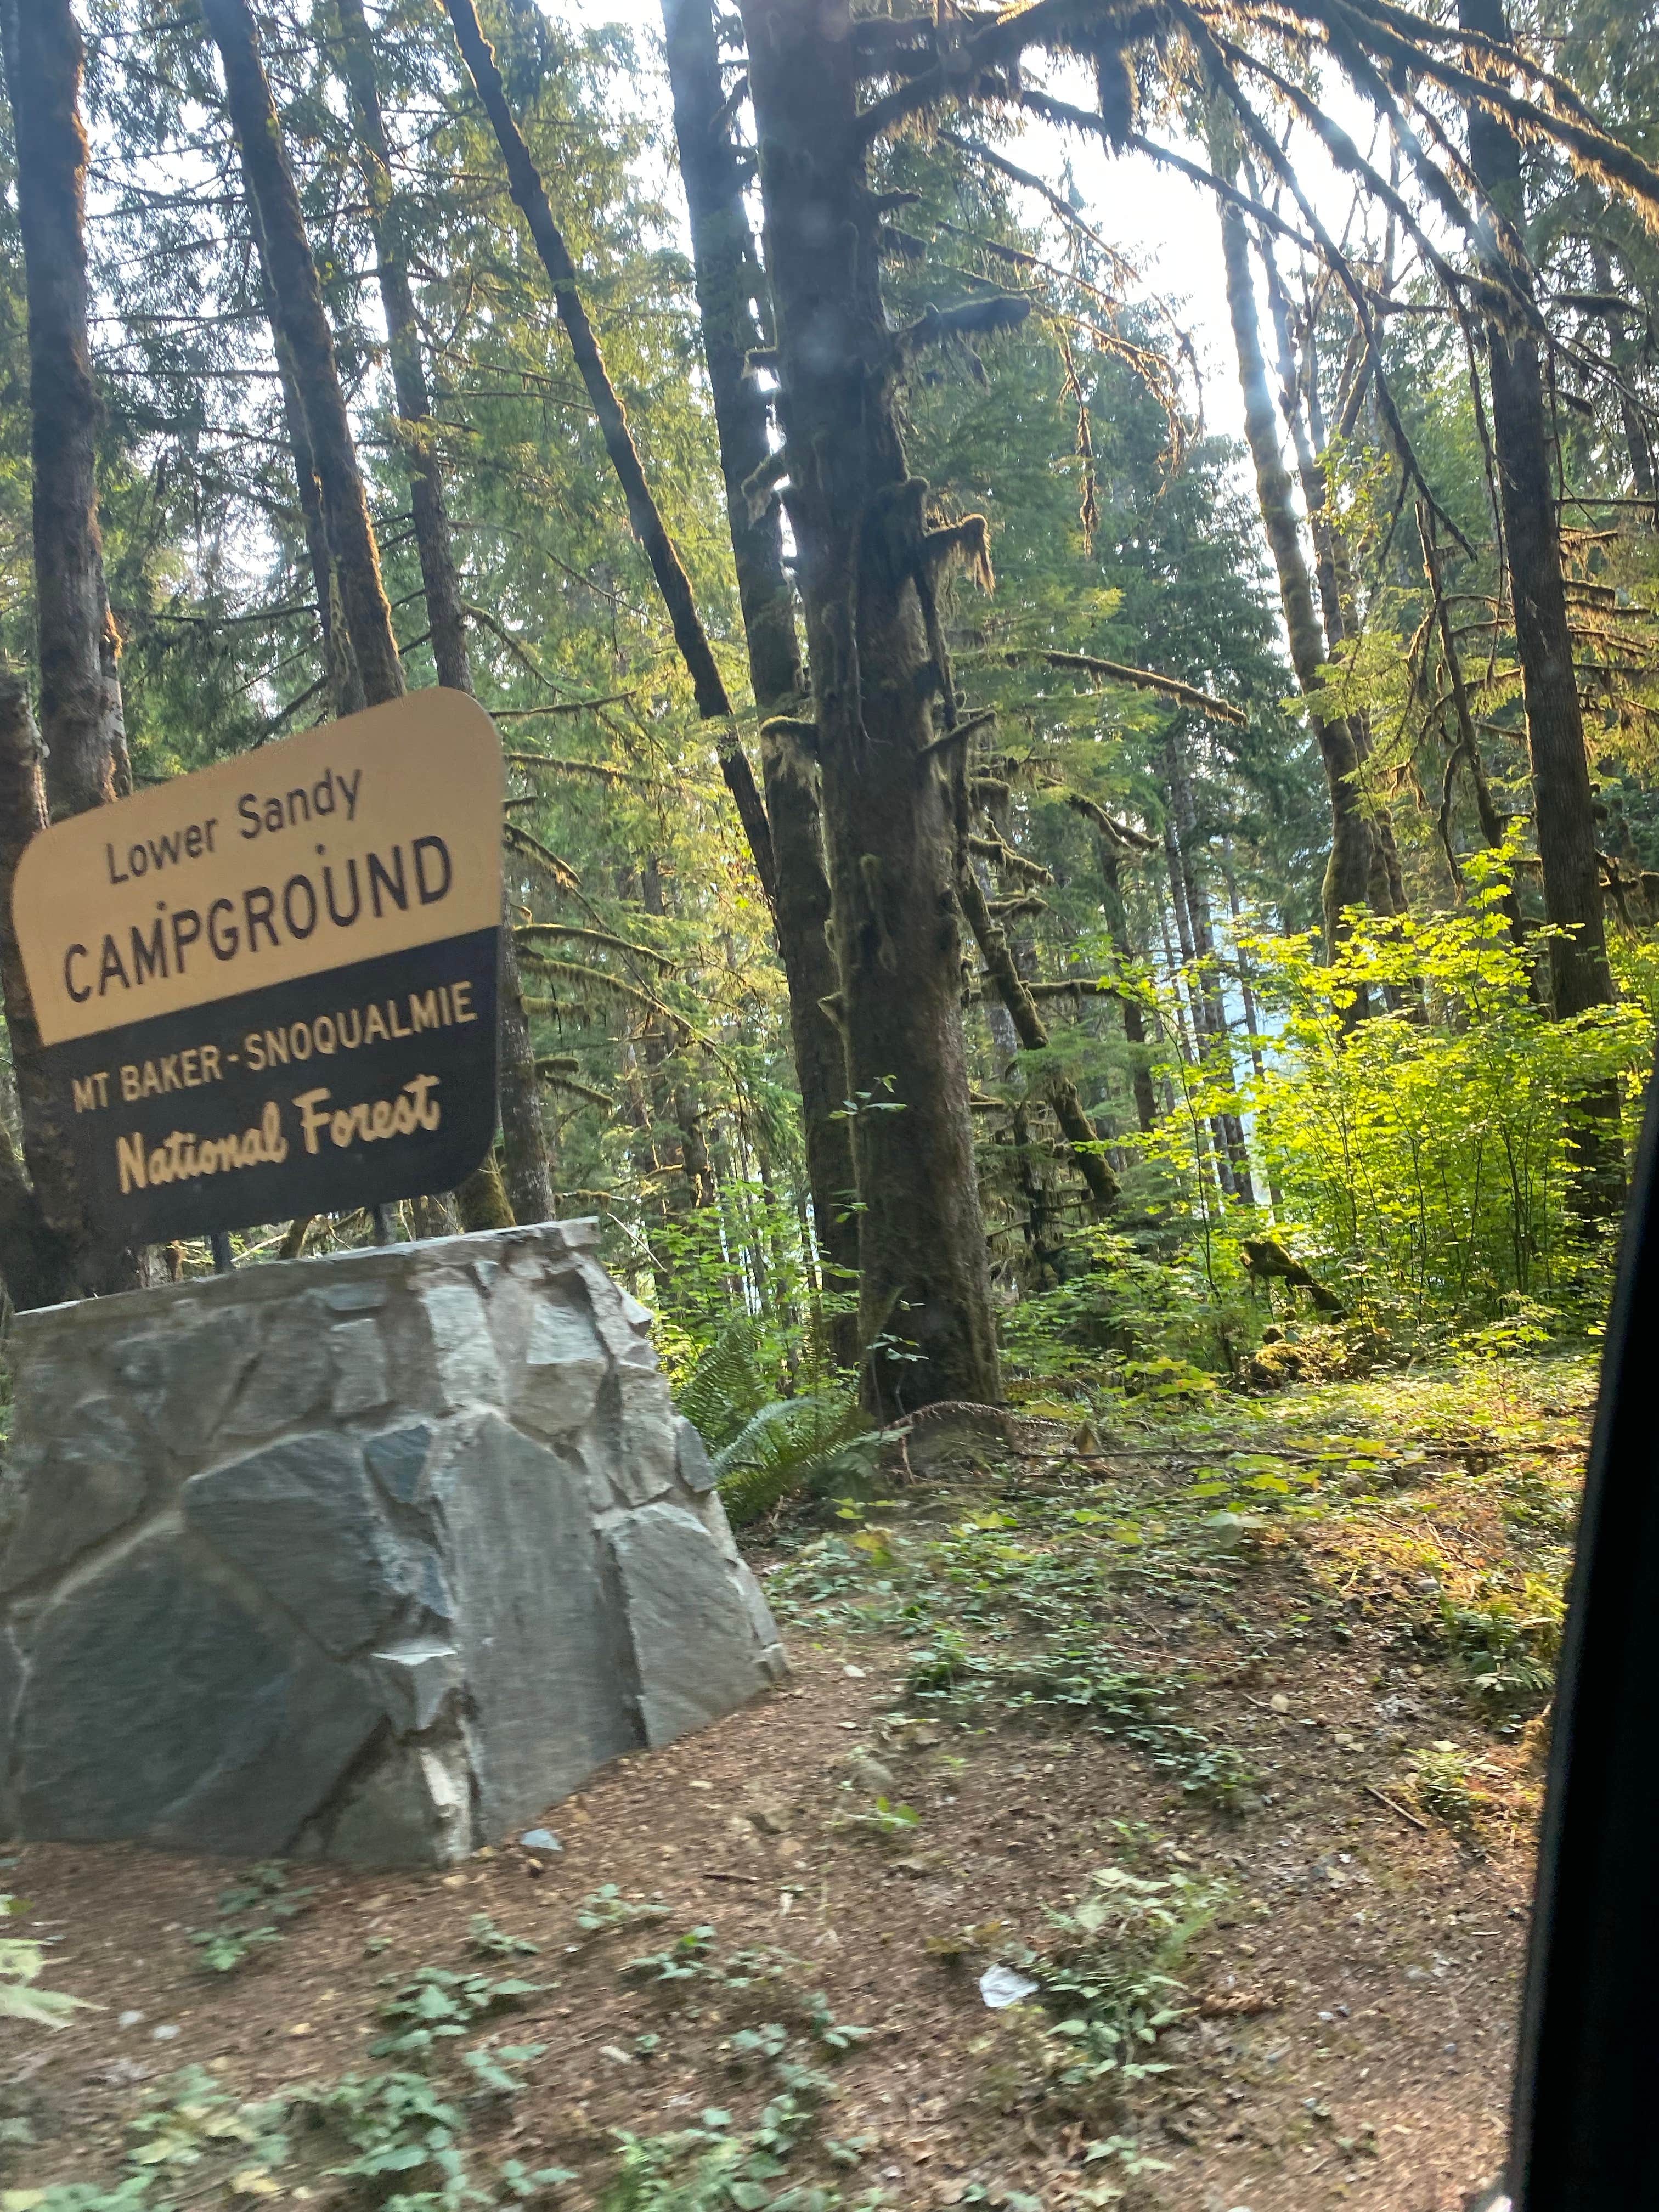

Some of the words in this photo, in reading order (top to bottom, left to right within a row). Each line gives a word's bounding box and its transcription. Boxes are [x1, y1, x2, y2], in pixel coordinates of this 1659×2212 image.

[107, 817, 218, 884] Lower
[237, 769, 363, 838] Sandy
[63, 834, 453, 1003] CAMPGROUND
[72, 1072, 110, 1113] MT
[115, 1101, 288, 1194] National
[292, 1074, 440, 1154] Forest
